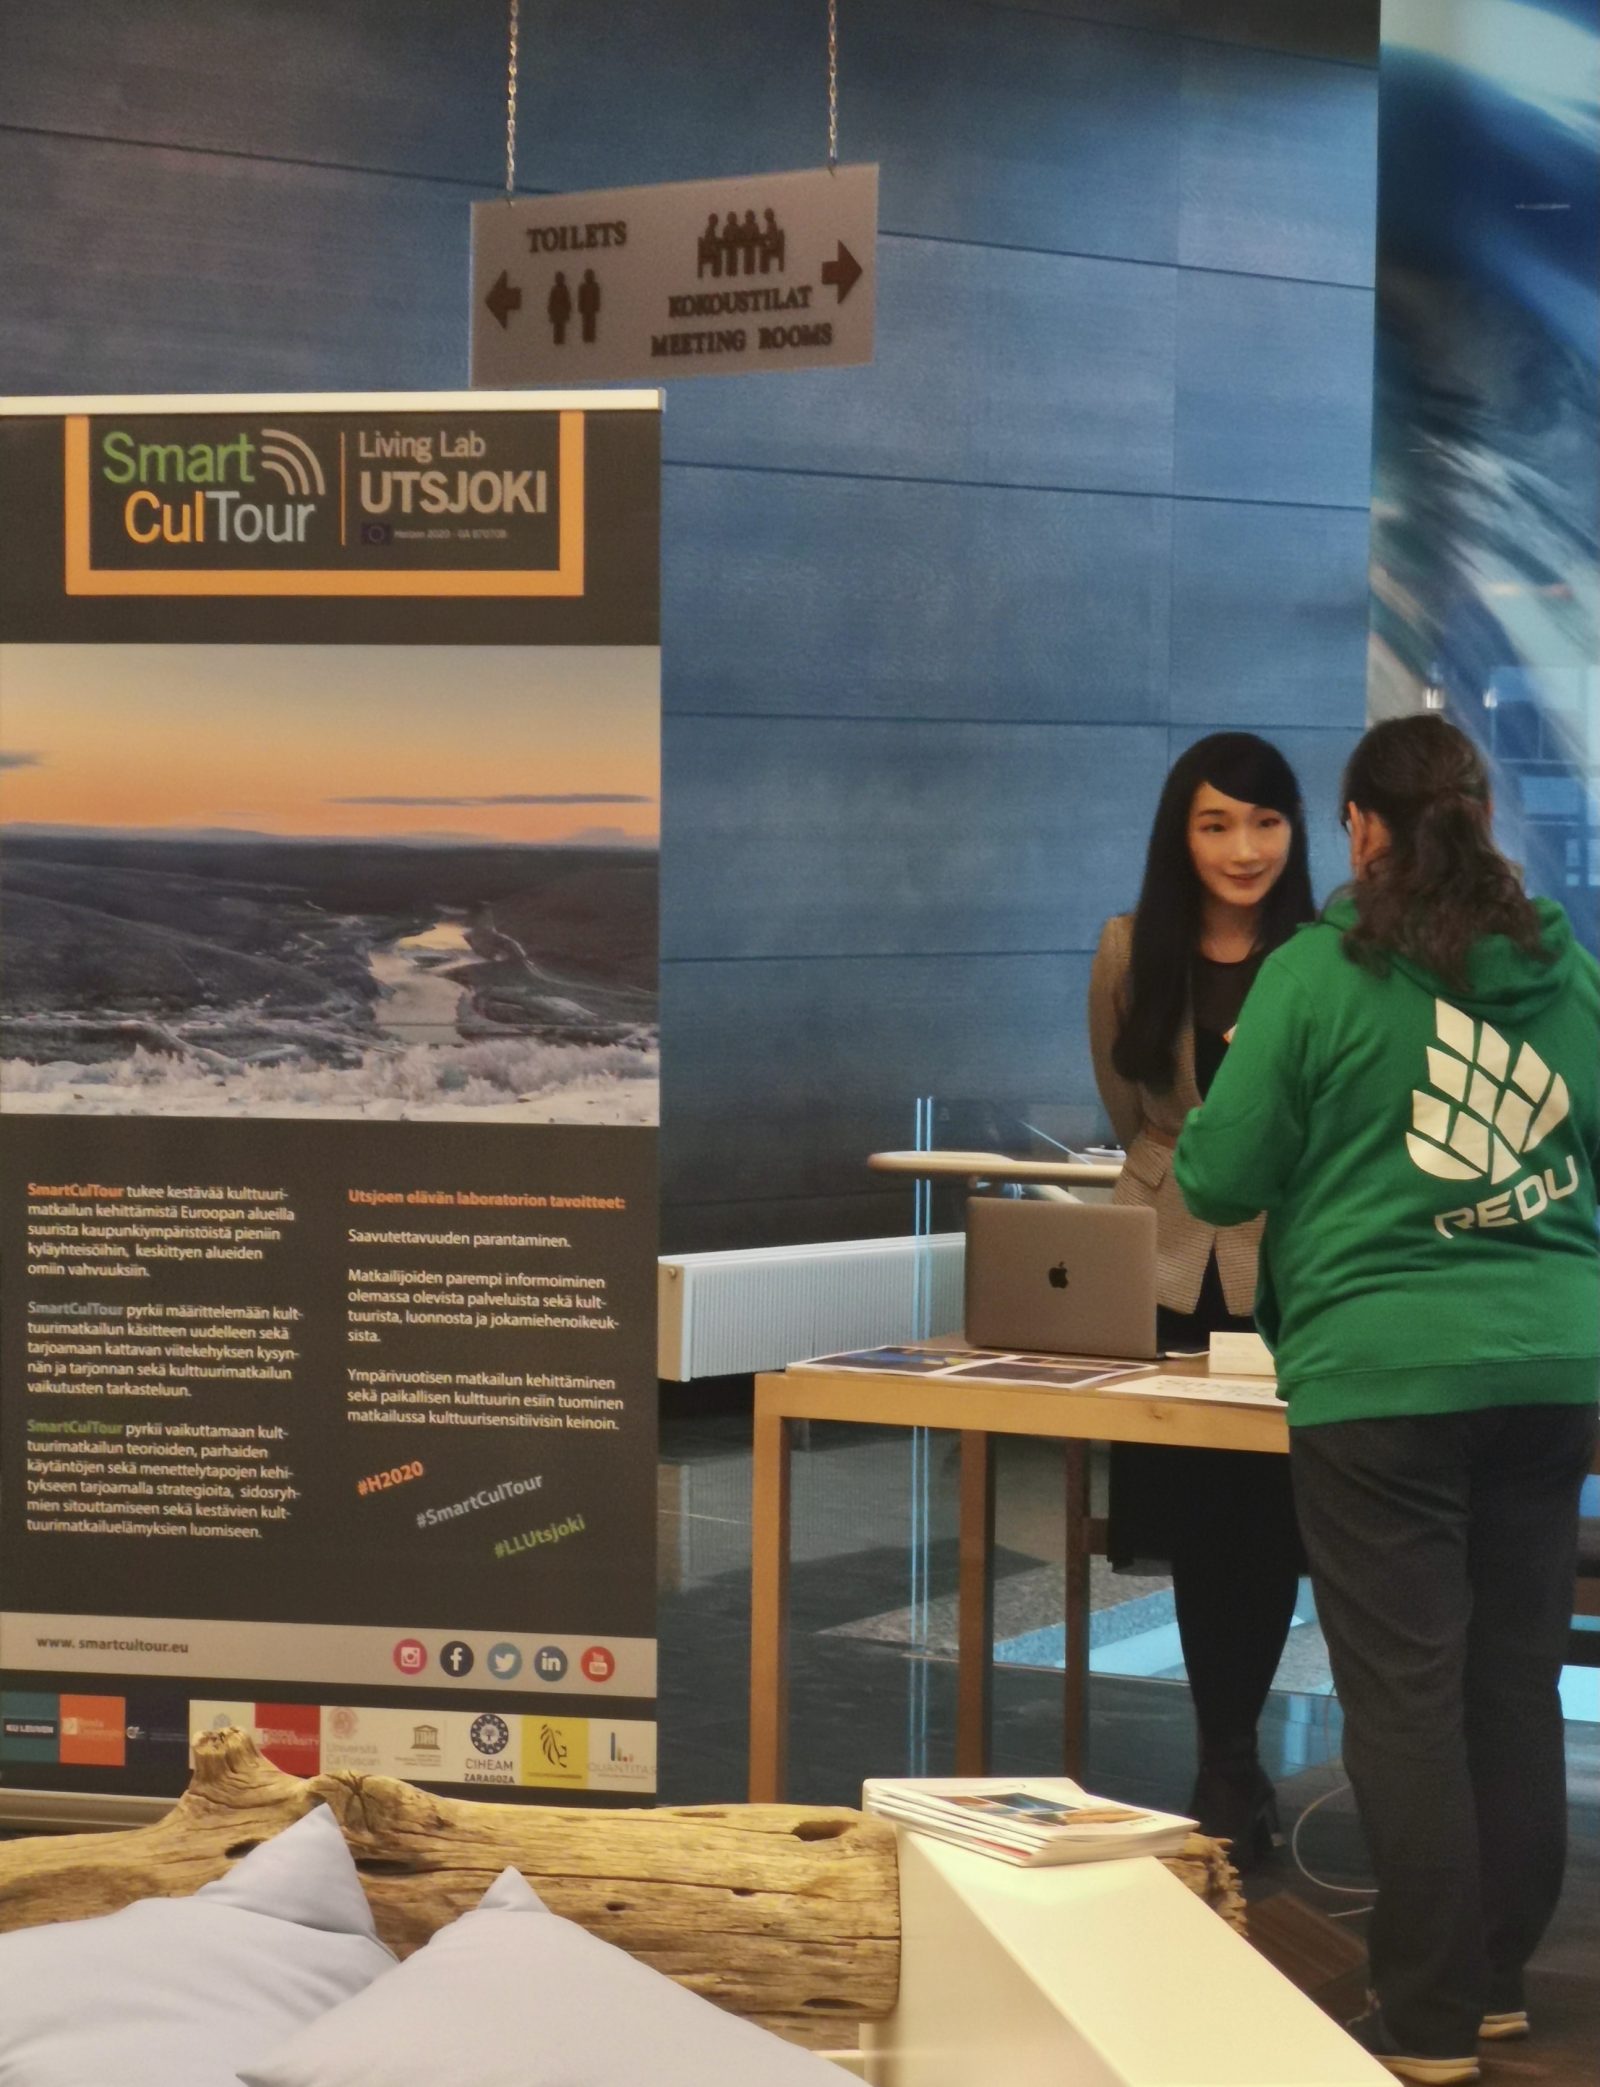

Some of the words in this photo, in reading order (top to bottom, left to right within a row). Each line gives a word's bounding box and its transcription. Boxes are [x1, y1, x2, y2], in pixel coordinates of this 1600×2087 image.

[525, 221, 627, 253] TOILETS
[668, 285, 813, 318] KOKOUSTILAT
[651, 329, 746, 357] MEETING
[758, 323, 833, 350] ROOMS
[103, 430, 256, 483] Smart
[359, 430, 433, 464] Living
[441, 430, 486, 457] Lab
[359, 469, 547, 514] UTSJOKI
[123, 489, 316, 543] CulTour
[28, 1183, 123, 1198] SmartCulTour
[127, 1185, 163, 1199] tukee
[167, 1185, 223, 1200] kestävää
[226, 1186, 288, 1201] kulttuuri-
[349, 1189, 403, 1205] Utsjoen
[407, 1191, 453, 1205] elävän
[457, 1191, 546, 1207] laboratorion
[550, 1195, 625, 1209] tavoitteet:
[1434, 1155, 1579, 1239] REDU
[28, 1204, 92, 1217] matkailun
[96, 1204, 177, 1218] kehittämistä
[181, 1206, 244, 1222] Euroopan
[248, 1207, 294, 1221] alueilla
[28, 1223, 78, 1236] suurista
[235, 1227, 280, 1241] pieniin
[348, 1229, 469, 1246] Saavutettavuuden
[474, 1233, 571, 1248] parantaminen.
[135, 1246, 201, 1260] keskittyen
[206, 1247, 262, 1260] alueiden
[28, 1263, 65, 1275] omiin
[348, 1269, 442, 1285] Matkailijoiden
[446, 1273, 502, 1287] parempi
[505, 1273, 605, 1289] informoiminen
[348, 1290, 409, 1303] olemassa
[413, 1291, 464, 1305] olevista
[468, 1292, 539, 1307] palveluista
[543, 1294, 572, 1308] sekä
[576, 1295, 606, 1309] kult-
[28, 1302, 123, 1316] SmartCulTour
[126, 1305, 162, 1319] pyrkii
[166, 1306, 270, 1319] määrittelemään
[273, 1307, 303, 1321] kult-
[348, 1310, 402, 1324] tuurista,
[406, 1311, 472, 1325] luonnosta
[476, 1312, 487, 1328] ja
[491, 1312, 619, 1329] jokamiehenoikeuk-
[28, 1322, 124, 1335] tuurimatkailun
[127, 1323, 186, 1337] käsitteen
[190, 1326, 256, 1338] uudelleen
[259, 1327, 288, 1340] sekä
[348, 1330, 381, 1342] sista.
[28, 1342, 101, 1357] tarjoamaan
[105, 1343, 161, 1357] kattavan
[165, 1345, 253, 1361] viitekehyksen
[257, 1346, 299, 1362] kysyn-
[28, 1362, 50, 1373] nän
[54, 1362, 66, 1376] ja
[70, 1363, 133, 1377] tarjonnan
[137, 1363, 166, 1376] sekä
[169, 1363, 291, 1380] kulttuurimatkailun
[347, 1369, 452, 1383] Ympärivuotisen
[456, 1372, 522, 1386] matkailun
[526, 1373, 615, 1389] kehittäminen
[28, 1381, 103, 1394] vaikutusten
[107, 1383, 191, 1397] tarkasteluun.
[347, 1389, 377, 1402] sekä
[381, 1390, 450, 1405] paikallisen
[454, 1391, 520, 1406] kulttuurin
[523, 1394, 554, 1407] esiin
[559, 1396, 623, 1409] tuominen
[27, 1419, 122, 1434] SmartCulTour
[126, 1423, 161, 1438] pyrkii
[165, 1424, 254, 1438] vaikuttamaan
[258, 1426, 288, 1439] kult-
[348, 1409, 425, 1423] matkailussa
[566, 1416, 619, 1430] keinoin.
[27, 1440, 123, 1453] tuurimatkailun
[126, 1443, 197, 1458] teorioiden,
[201, 1446, 268, 1461] parhaiden
[27, 1459, 104, 1474] käytäntöjen
[107, 1461, 136, 1474] sekä
[140, 1463, 257, 1479] menettelytapojen
[260, 1466, 293, 1479] kehi-
[356, 1460, 424, 1496] #H2020
[27, 1481, 77, 1494] tykseen
[81, 1481, 153, 1496] tarjoamalla
[157, 1484, 234, 1499] strategioita,
[240, 1485, 300, 1501] sidosryh-
[27, 1500, 59, 1512] mien
[63, 1501, 159, 1515] sitouttamiseen
[163, 1503, 192, 1516] sekä
[195, 1504, 257, 1518] kestävien
[261, 1506, 292, 1519] kult-
[416, 1475, 543, 1528] #SmartCulTour
[190, 1523, 262, 1538] luomiseen.
[494, 1514, 586, 1558] #LLUtsjoki
[36, 1638, 75, 1649] www.
[79, 1639, 189, 1654] smartcultour.eu
[465, 1758, 513, 1771] CIHEAM
[464, 1773, 515, 1784] ZARAGOZA
